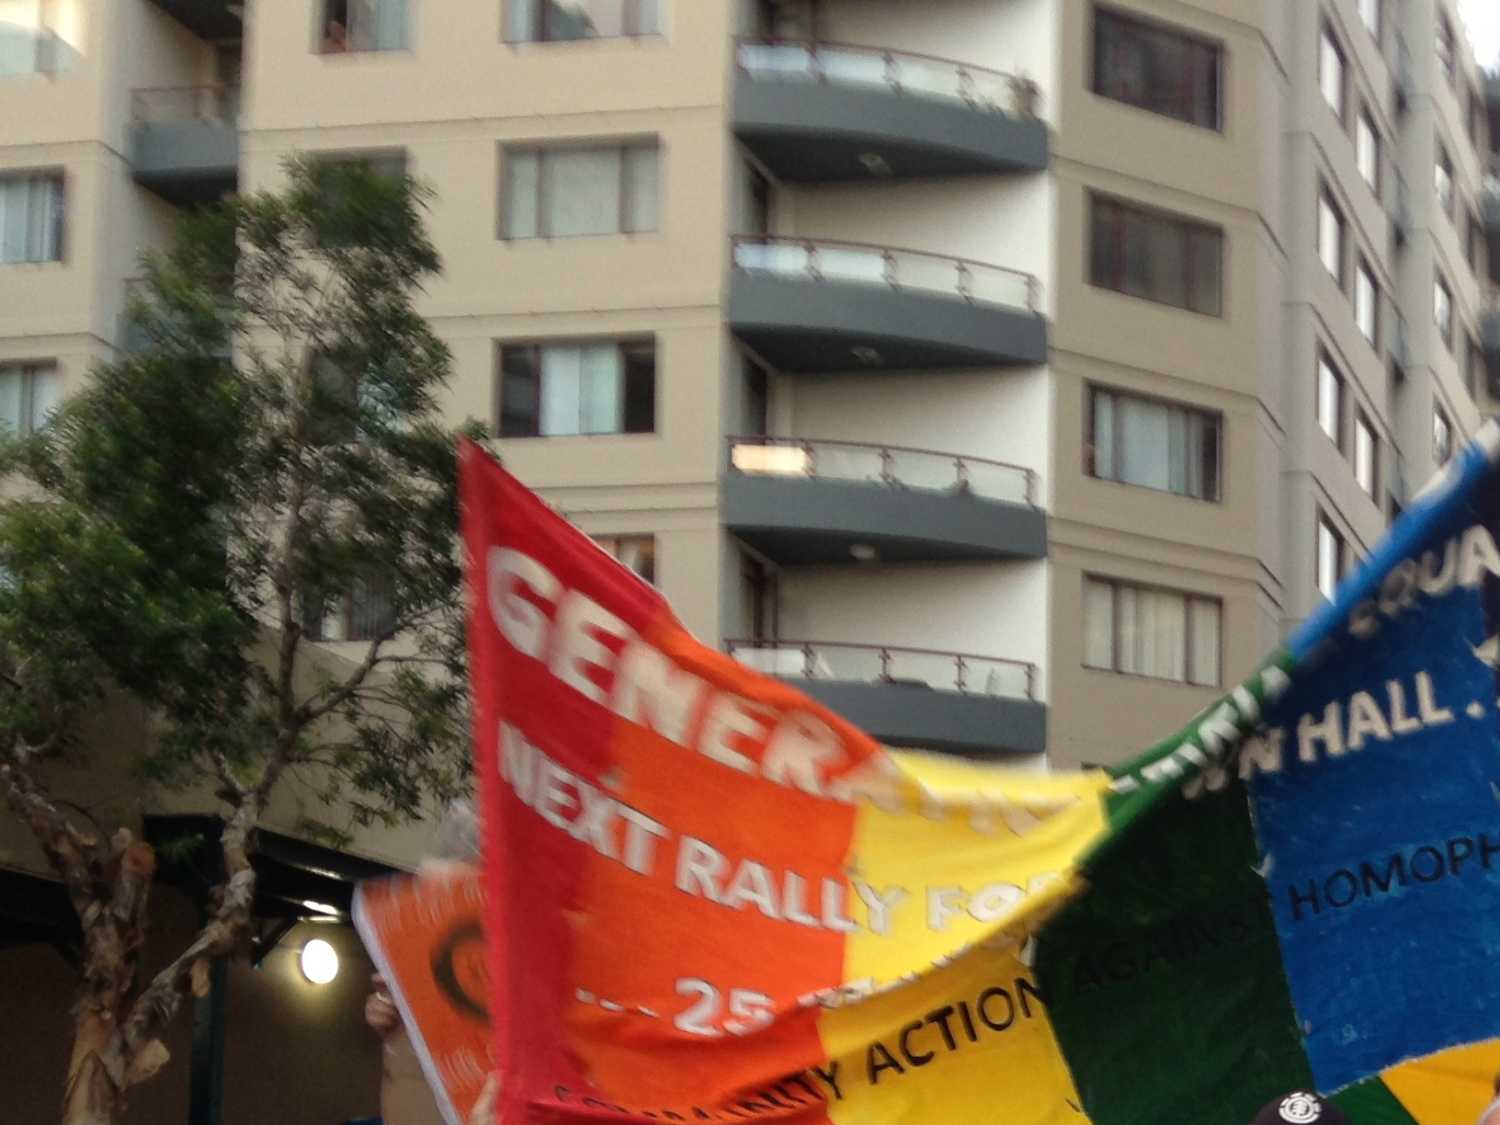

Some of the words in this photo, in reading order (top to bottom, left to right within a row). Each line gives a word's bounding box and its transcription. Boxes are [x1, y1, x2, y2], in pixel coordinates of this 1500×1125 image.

[496, 719, 665, 876] NEXT
[675, 838, 908, 934] RALLY
[867, 977, 1043, 1086] ACTION
